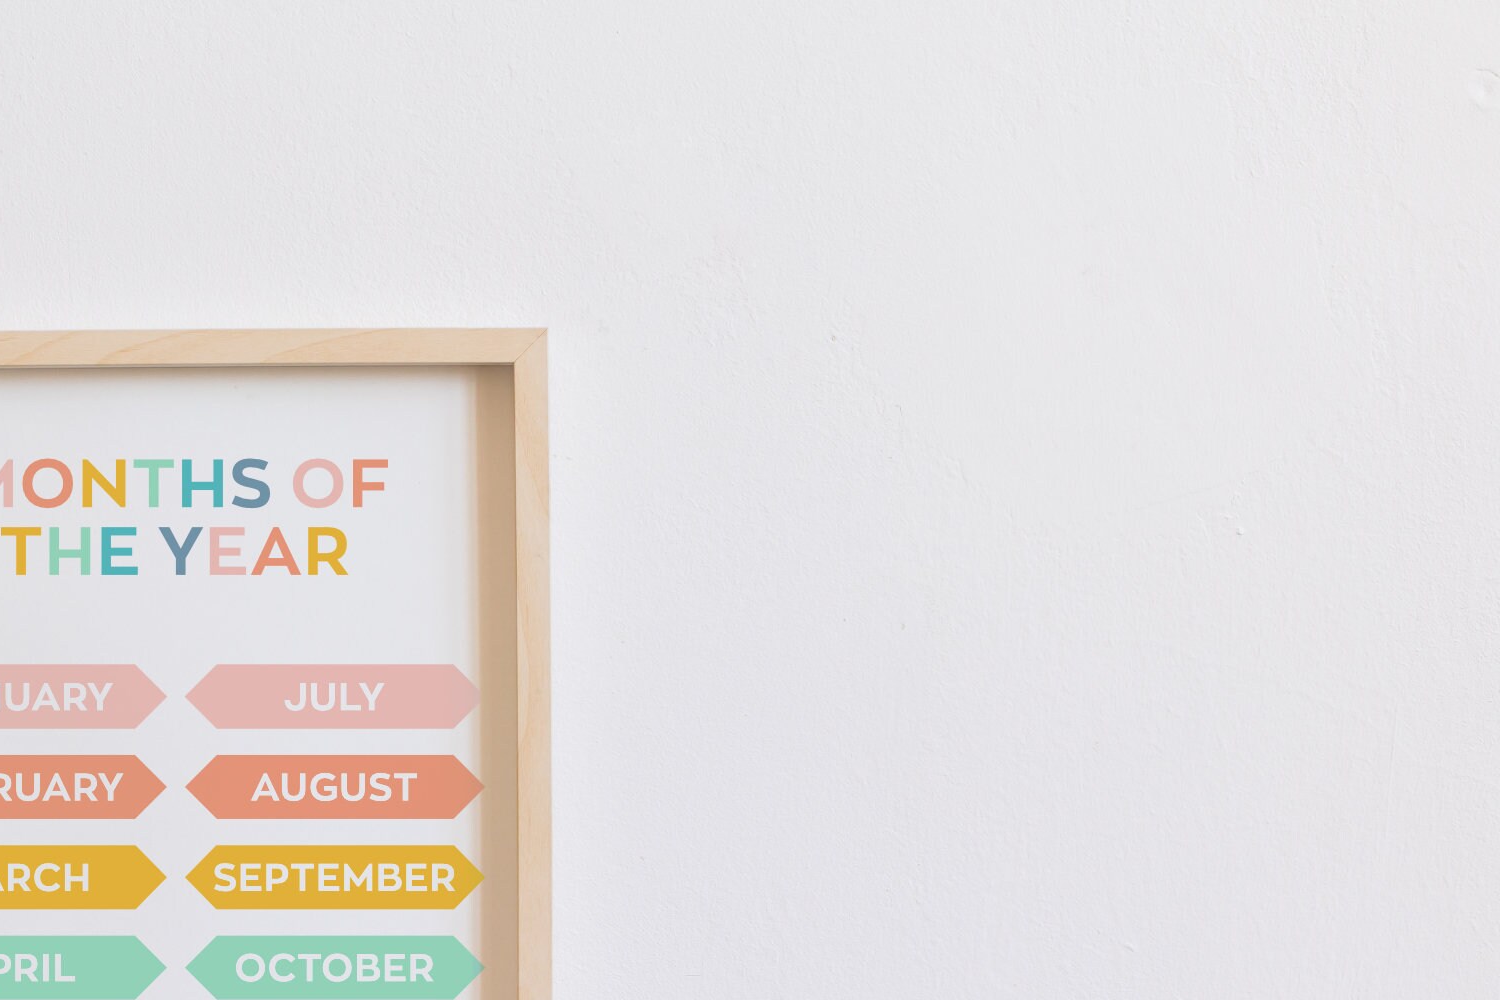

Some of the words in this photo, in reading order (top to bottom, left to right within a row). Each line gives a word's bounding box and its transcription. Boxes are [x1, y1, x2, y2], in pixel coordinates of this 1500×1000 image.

[292, 457, 389, 510] OF
[158, 525, 350, 577] YEAR
[283, 681, 385, 712] JULY
[251, 772, 418, 802] AUGUST
[213, 862, 455, 893] SEPTEMBER
[235, 952, 434, 983] OCTOBER
